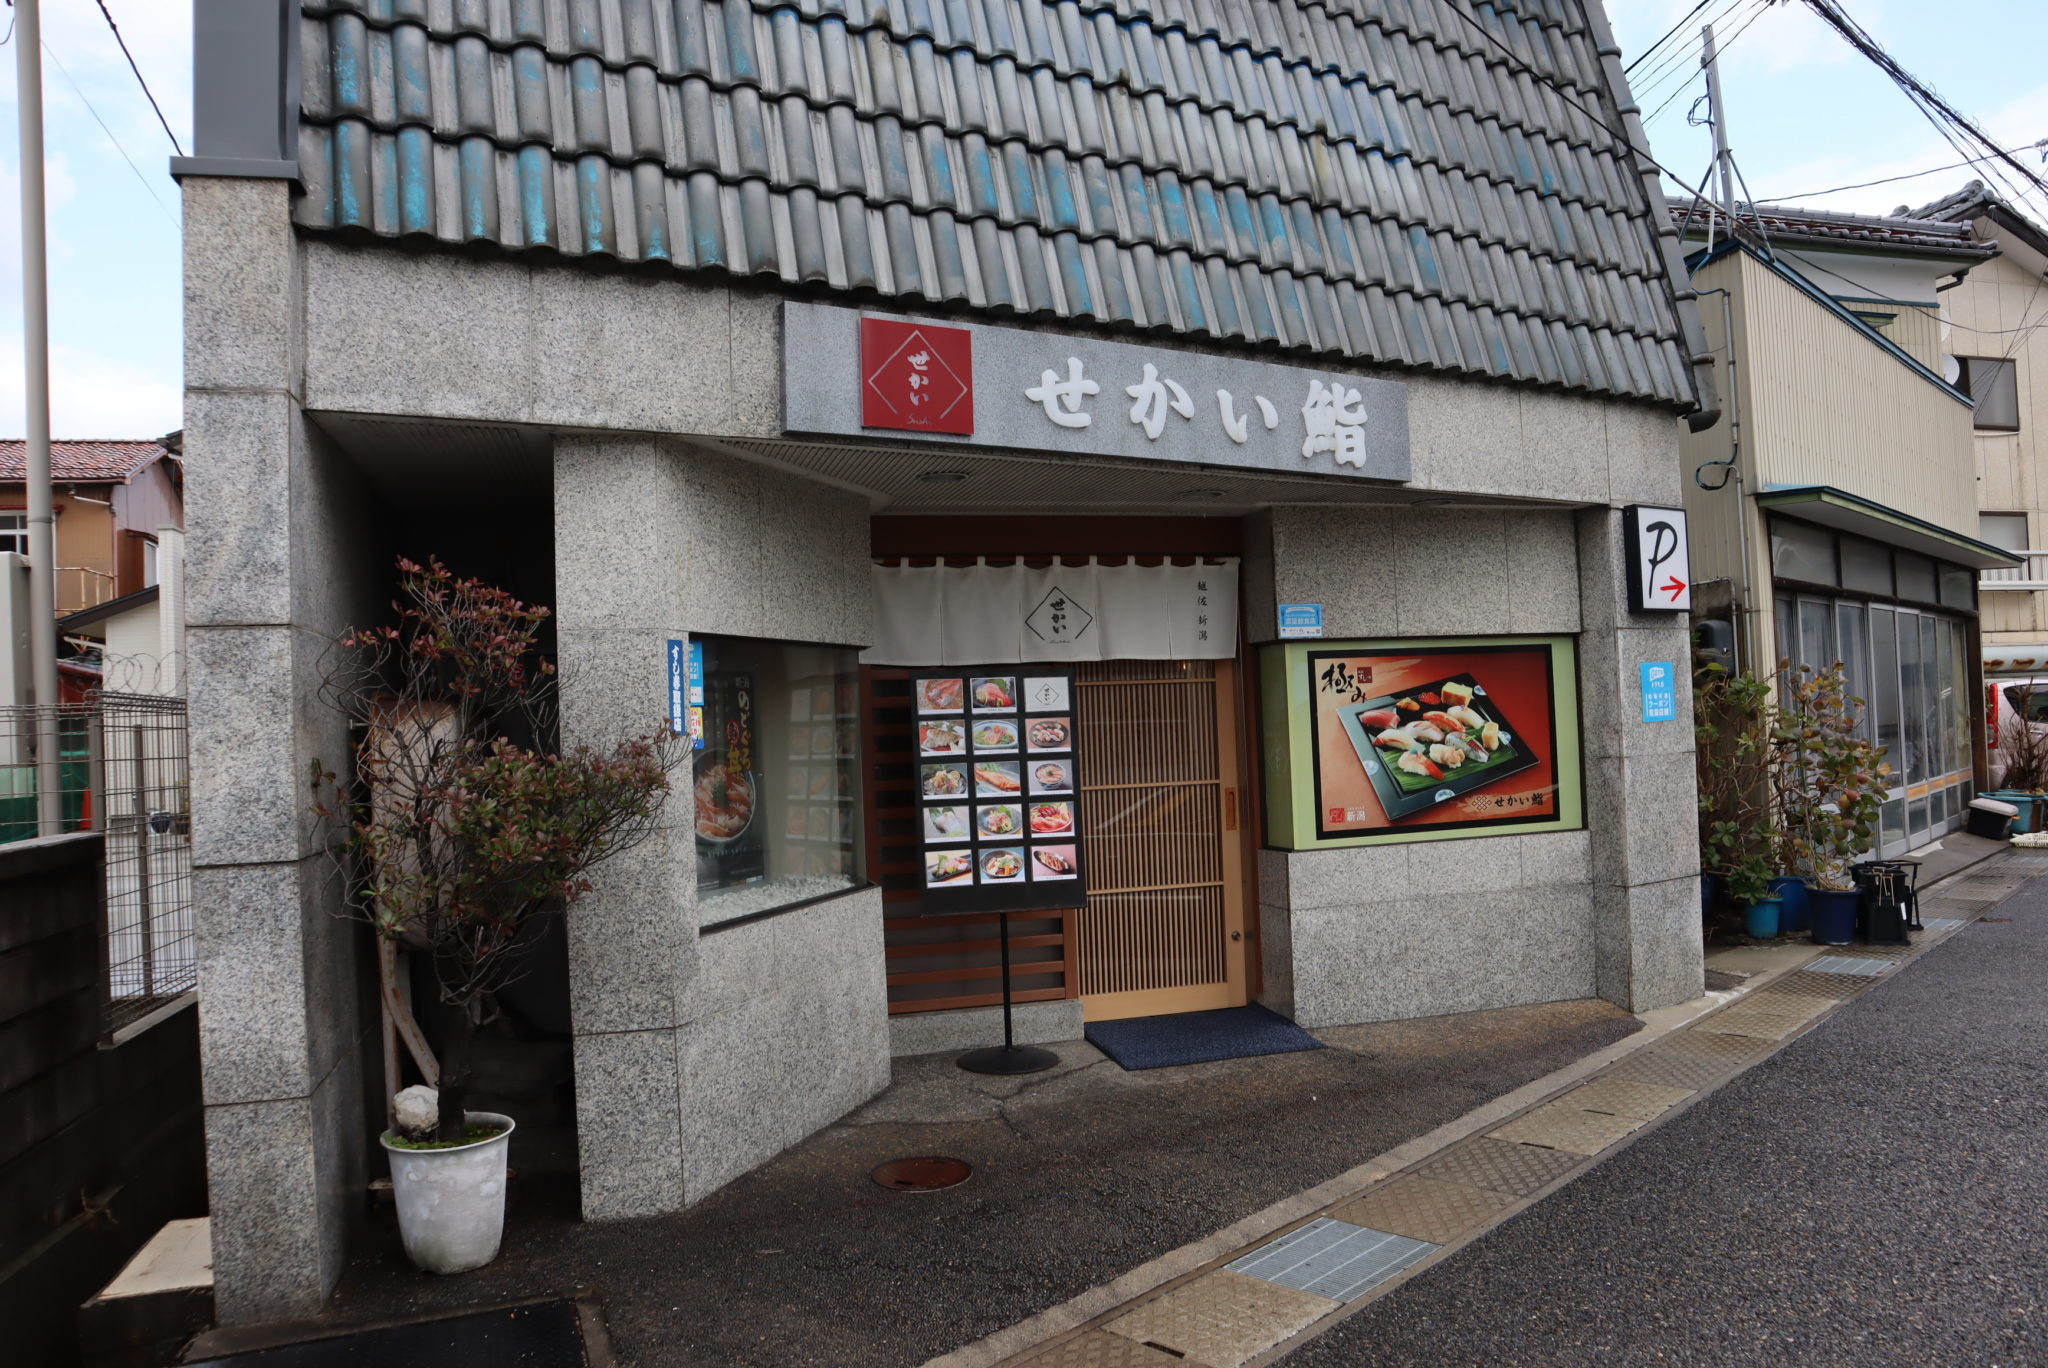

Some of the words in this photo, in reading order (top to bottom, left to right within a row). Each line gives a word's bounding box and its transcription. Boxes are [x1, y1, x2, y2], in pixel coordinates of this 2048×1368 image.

[1025, 357, 1368, 468] せかい鮨
[1646, 521, 1677, 599] P
[1494, 792, 1544, 807] せかい鮨
